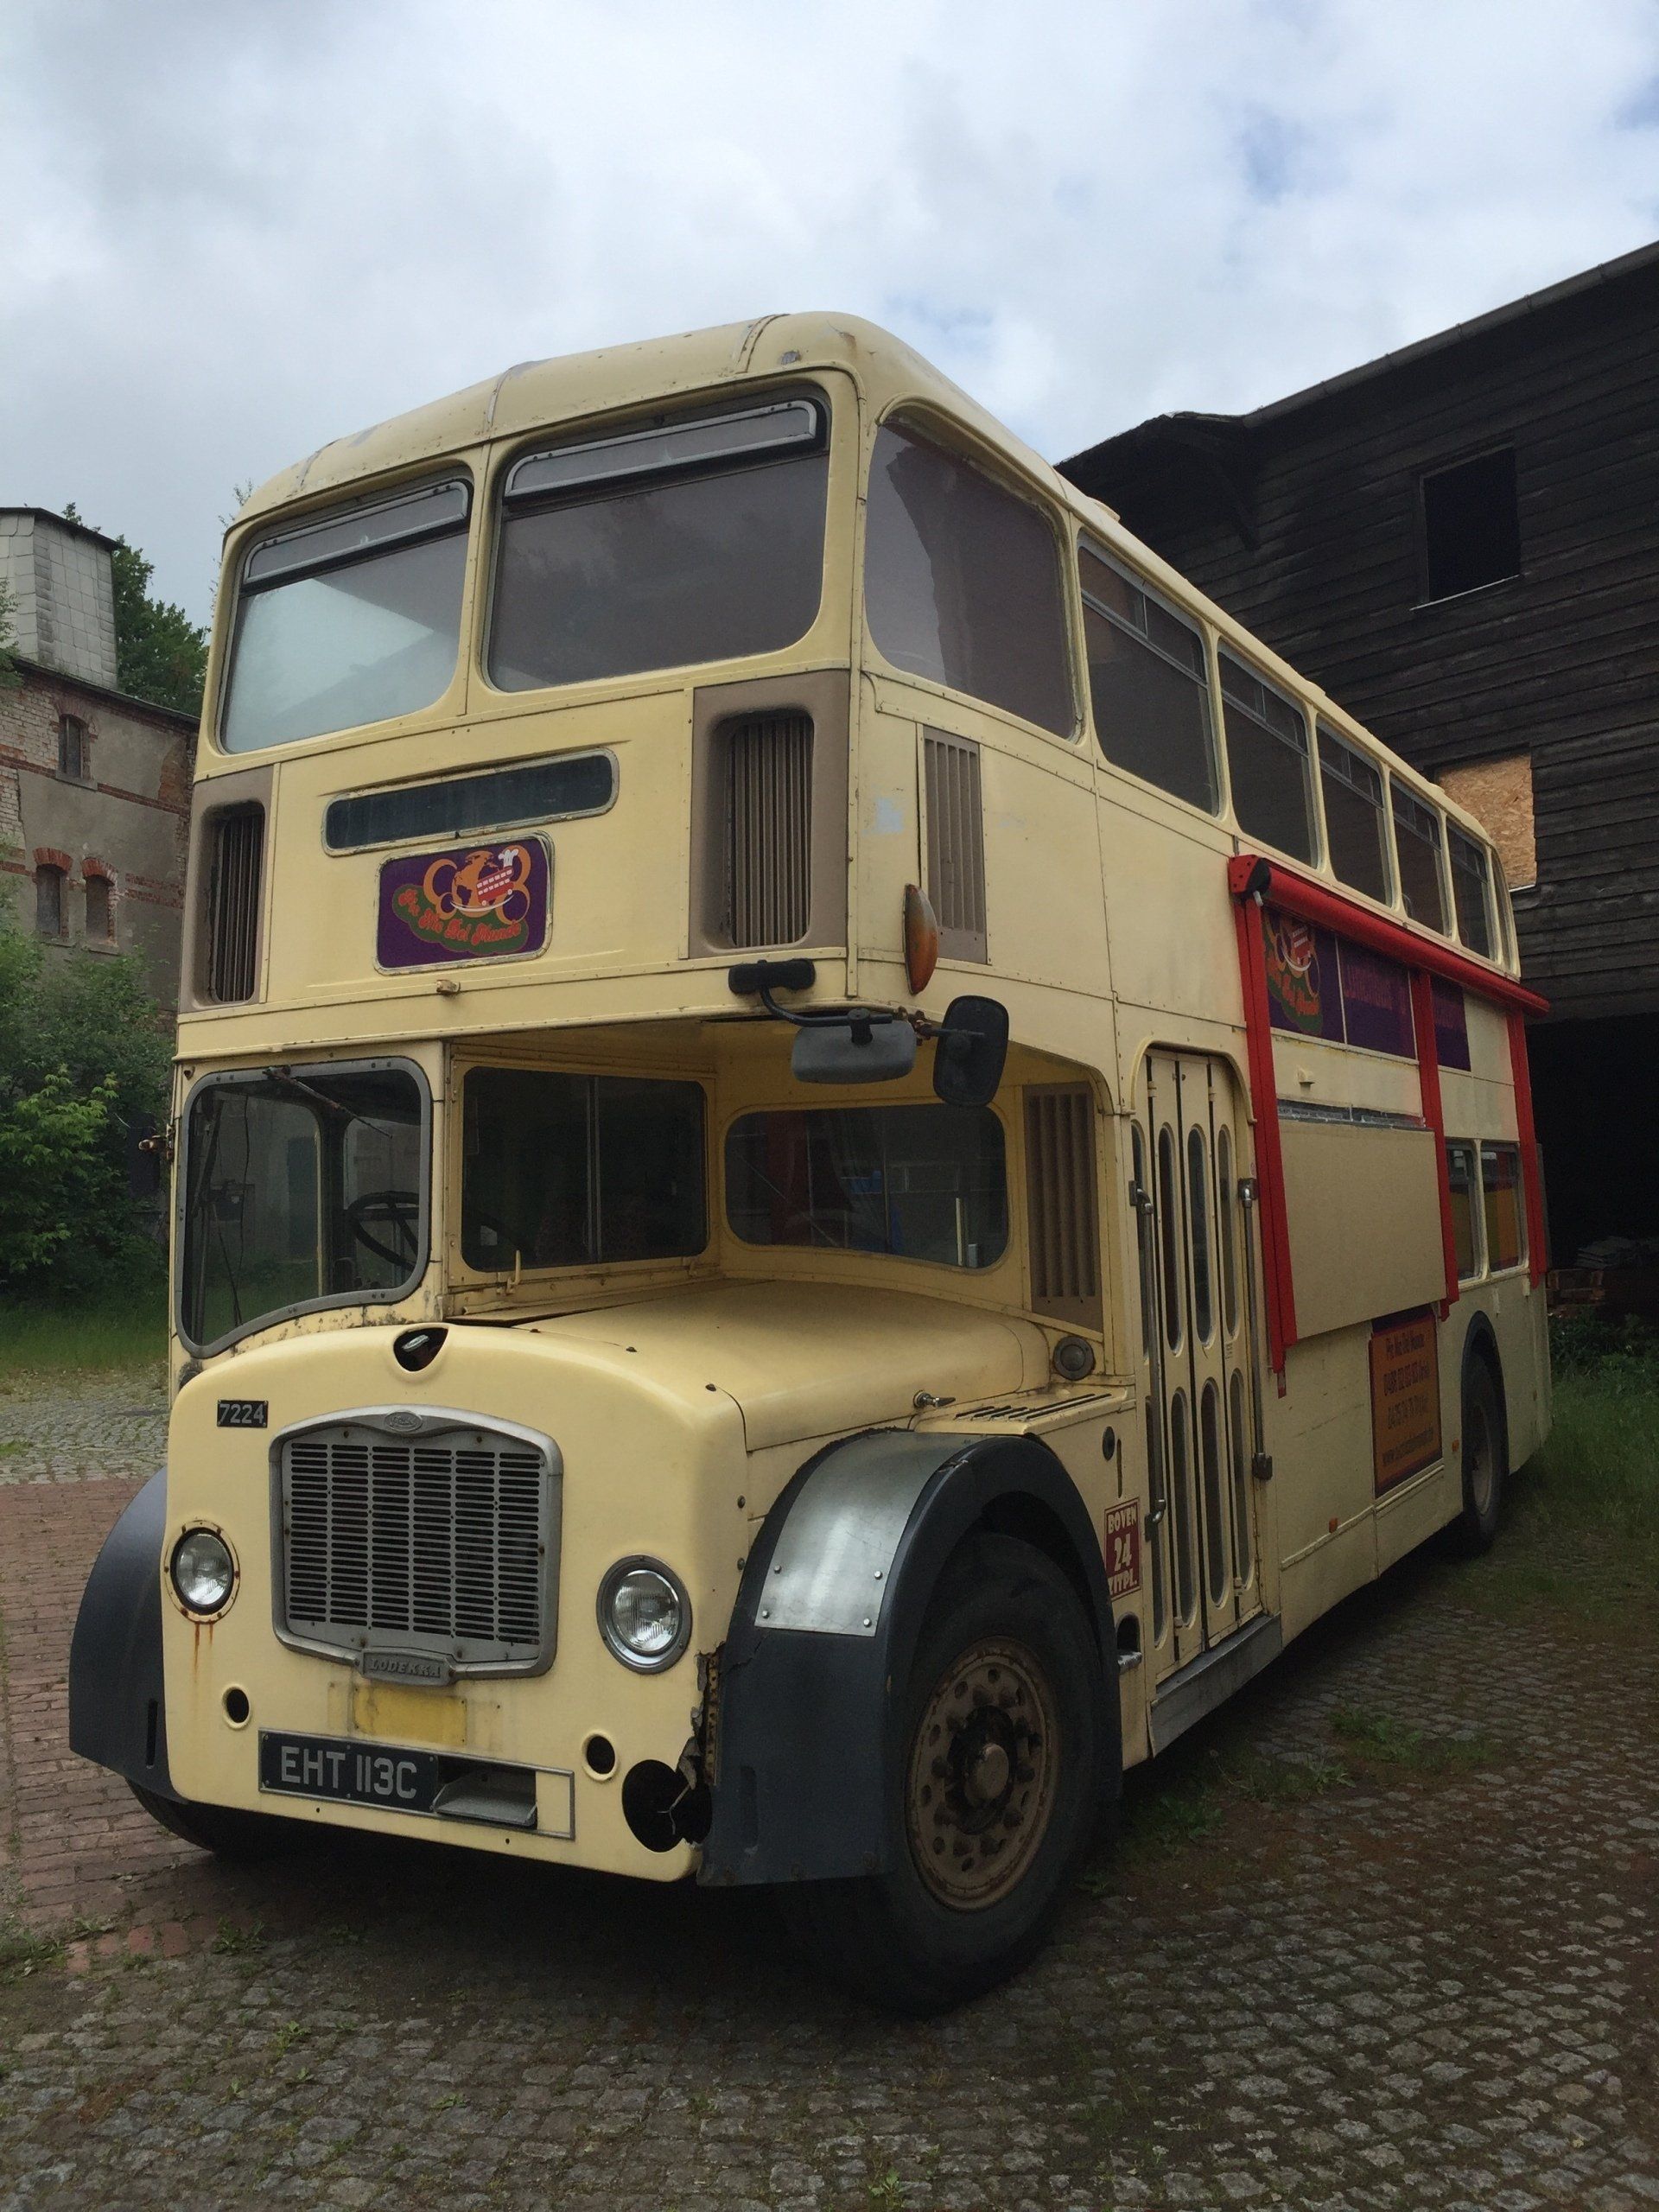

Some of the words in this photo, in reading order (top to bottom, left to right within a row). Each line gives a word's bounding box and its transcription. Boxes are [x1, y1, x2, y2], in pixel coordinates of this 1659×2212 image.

[219, 1403, 264, 1424] 7224
[1108, 1506, 1137, 1534] BOVEN
[1114, 1533, 1132, 1572] 24
[369, 1659, 442, 1678] LODEKKA
[281, 1745, 346, 1789] EHT
[356, 1754, 417, 1799] 113C
